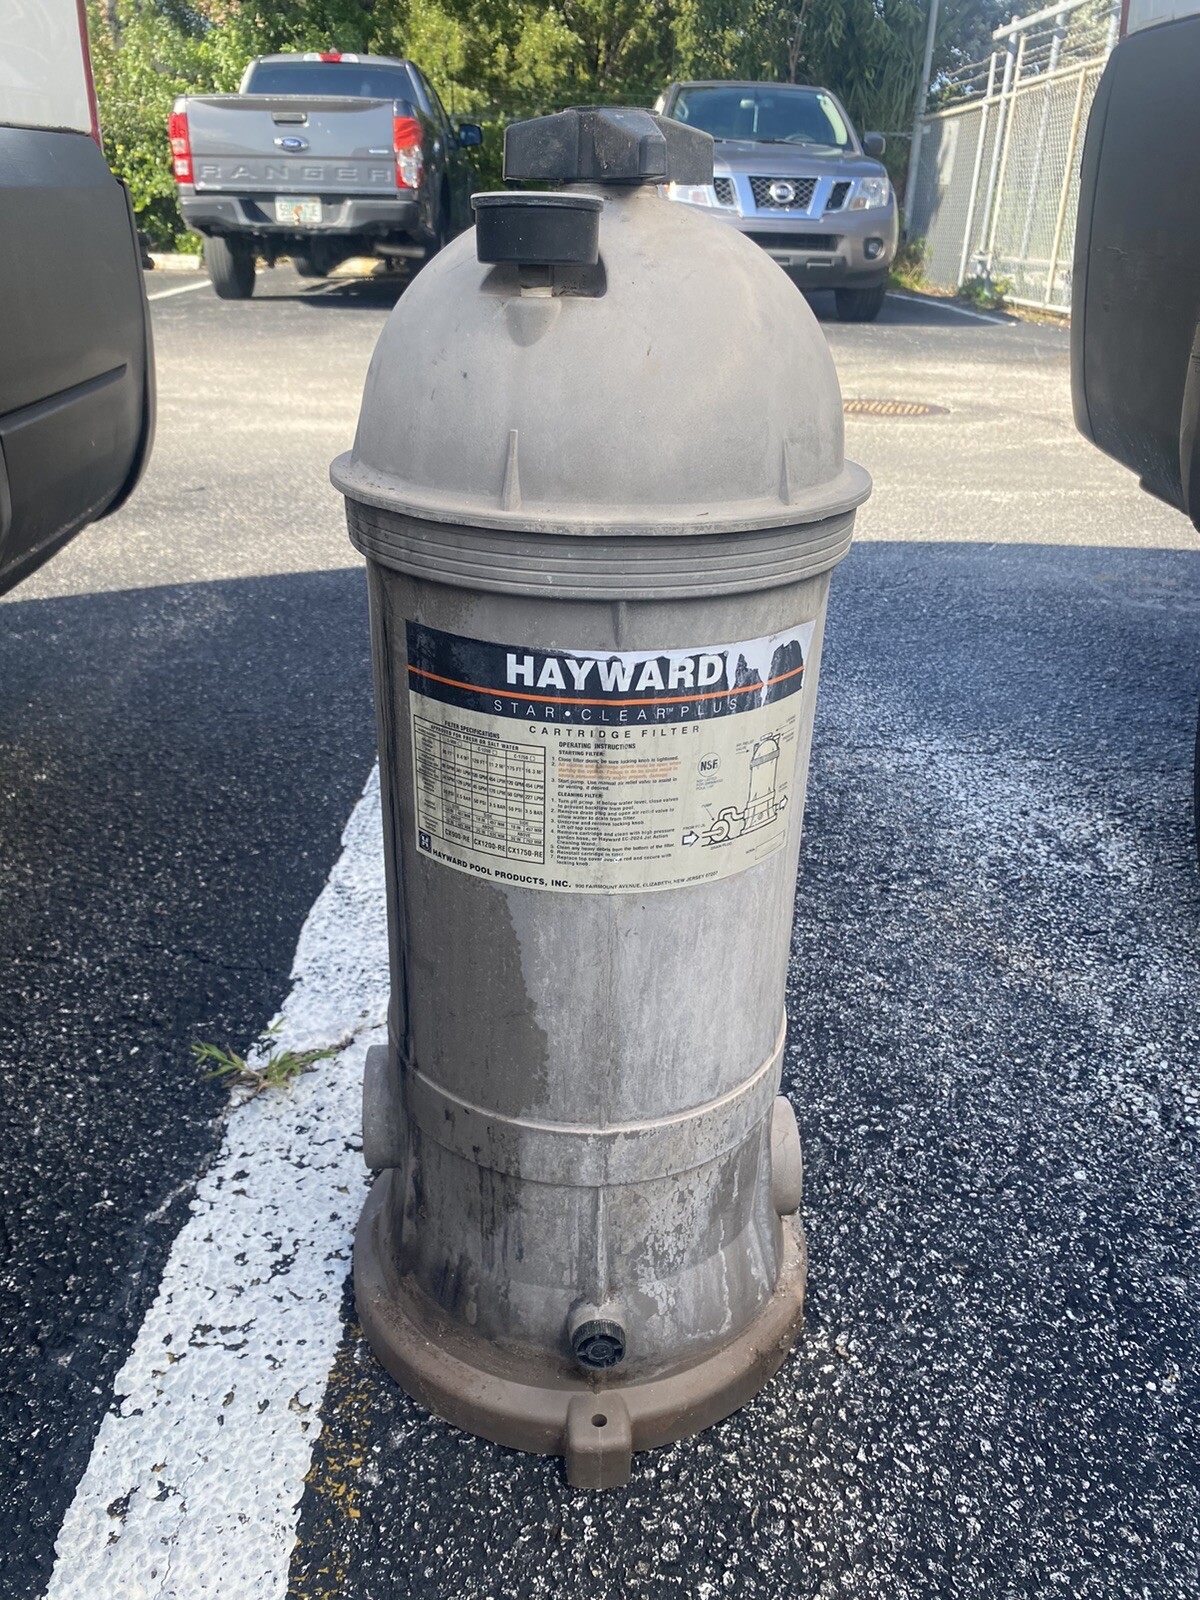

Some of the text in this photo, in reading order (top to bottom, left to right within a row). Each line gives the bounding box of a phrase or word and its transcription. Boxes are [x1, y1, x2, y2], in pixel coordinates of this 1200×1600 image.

[200, 165, 392, 182] RANGER
[506, 653, 724, 692] HAYWARD
[430, 724, 452, 736] APPROVED
[463, 734, 478, 743] FRESH
[444, 720, 500, 739] FILTER SPECIFICATIONS
[529, 725, 700, 739] CARTRIDGE FILTER
[700, 759, 718, 772] NSF
[474, 838, 506, 852] CX1200-RE
[508, 846, 543, 858] CX1750-RE
[432, 849, 572, 888] HAYWARD POOL PRODUCTS, INC.
